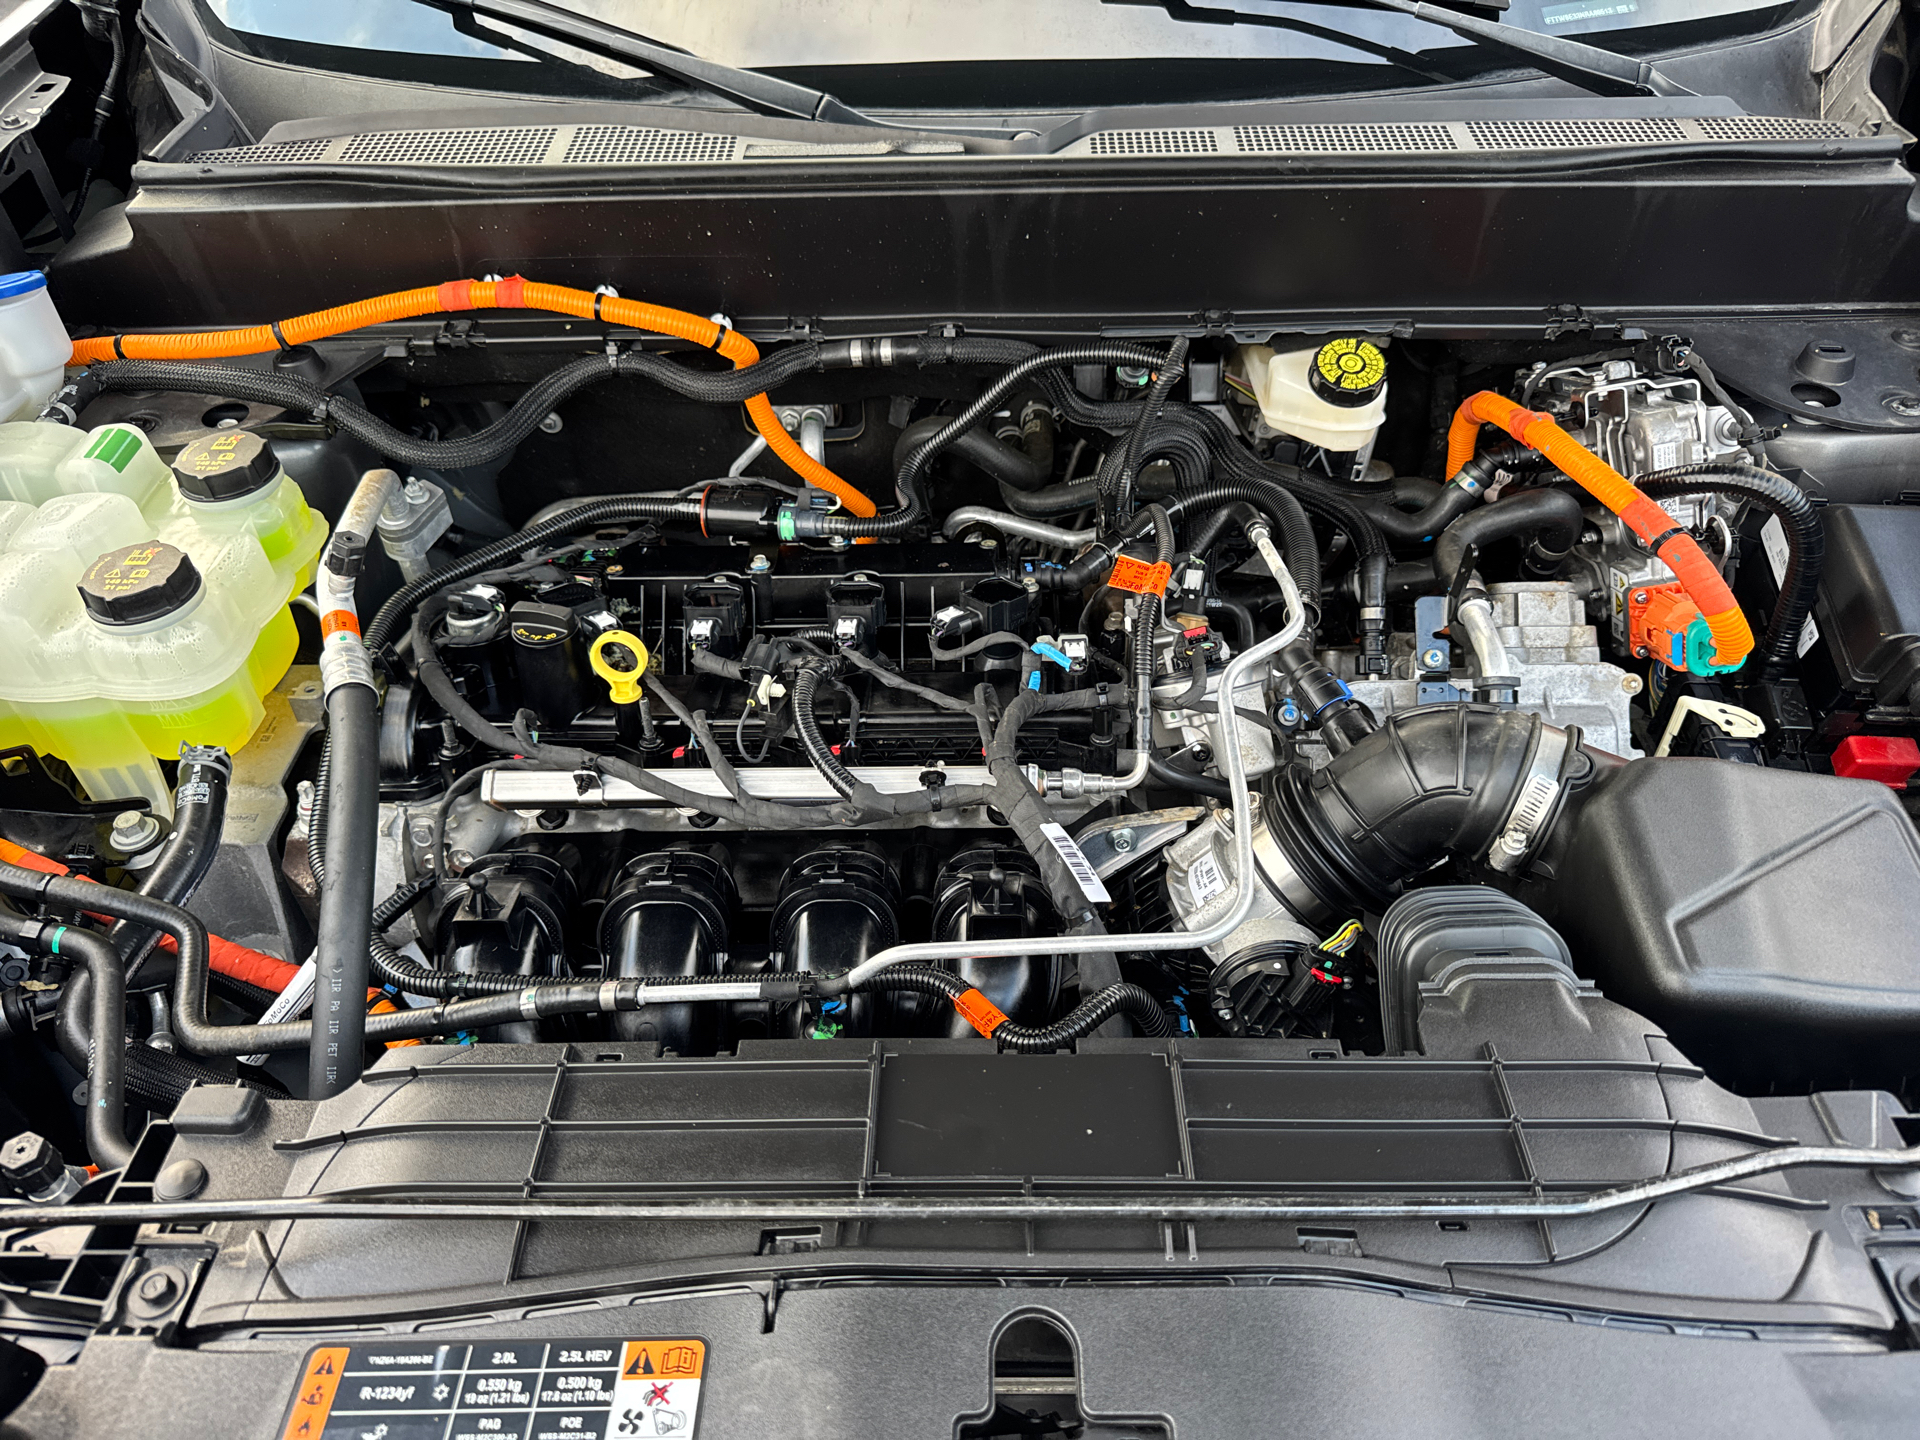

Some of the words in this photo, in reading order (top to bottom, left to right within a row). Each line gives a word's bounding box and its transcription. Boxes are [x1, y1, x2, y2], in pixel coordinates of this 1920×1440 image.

[1131, 581, 1158, 590] FoMo
[156, 711, 197, 728] MIN
[330, 1000, 341, 1012] PA
[327, 1042, 338, 1057] PET
[491, 1352, 518, 1364] 2.0L
[558, 1350, 584, 1363] 2.5L
[585, 1349, 613, 1362] HEV
[476, 1378, 507, 1391] 0.550
[507, 1378, 523, 1393] kg
[556, 1376, 587, 1390] 0.500
[588, 1376, 603, 1391] kg
[359, 1385, 416, 1403] R-1234yf
[476, 1394, 489, 1404] oz
[489, 1392, 510, 1405] (1.21
[511, 1391, 530, 1405] lbs)
[561, 1392, 572, 1402] oz
[597, 1389, 615, 1403] lbs)
[559, 1416, 584, 1429] POE
